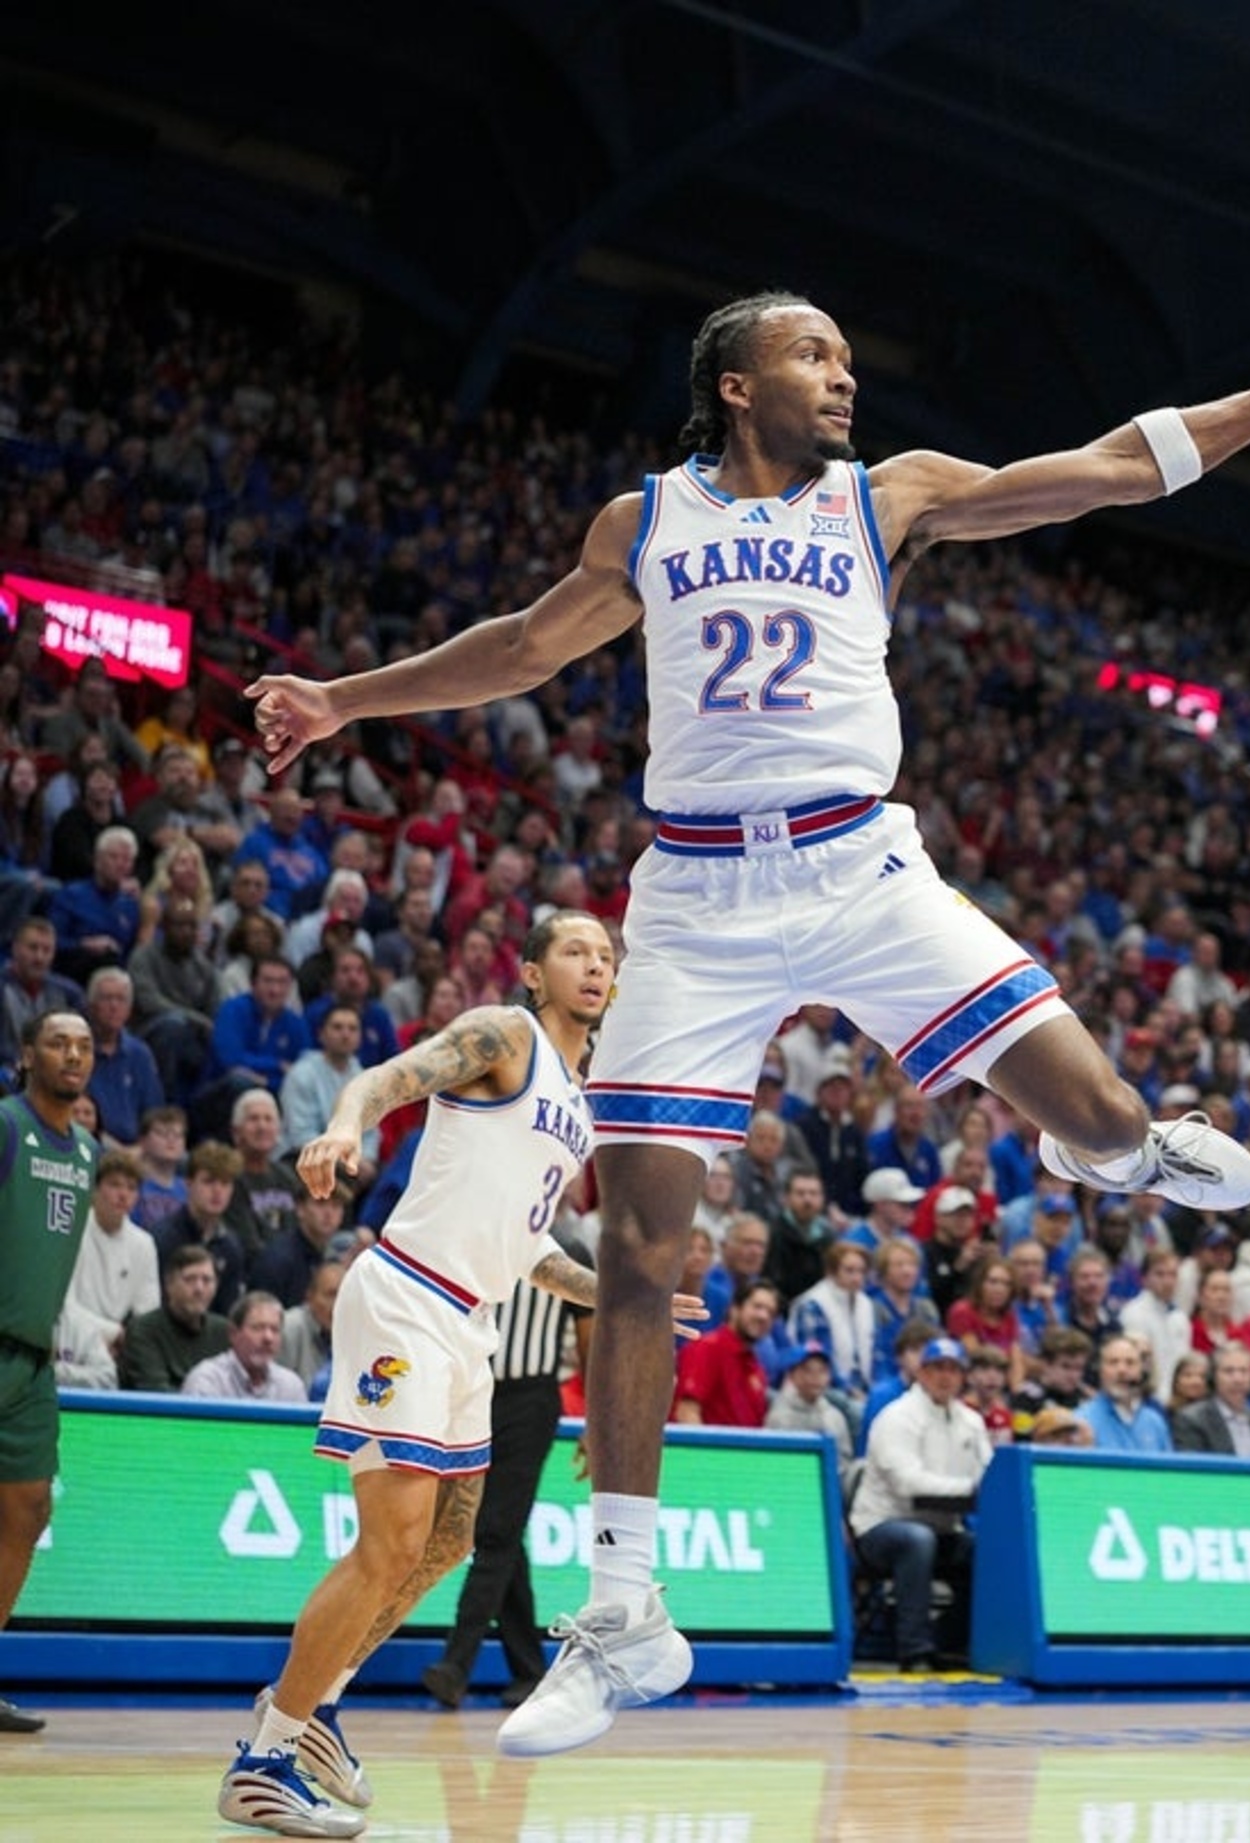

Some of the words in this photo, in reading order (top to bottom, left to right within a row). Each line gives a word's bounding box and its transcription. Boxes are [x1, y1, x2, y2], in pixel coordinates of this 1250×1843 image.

[660, 537, 855, 602] KANSAS
[699, 609, 818, 714] 22
[752, 824, 780, 843] KU
[532, 1098, 588, 1165] KANSA
[47, 1186, 77, 1236] 15
[528, 1164, 563, 1234] 3
